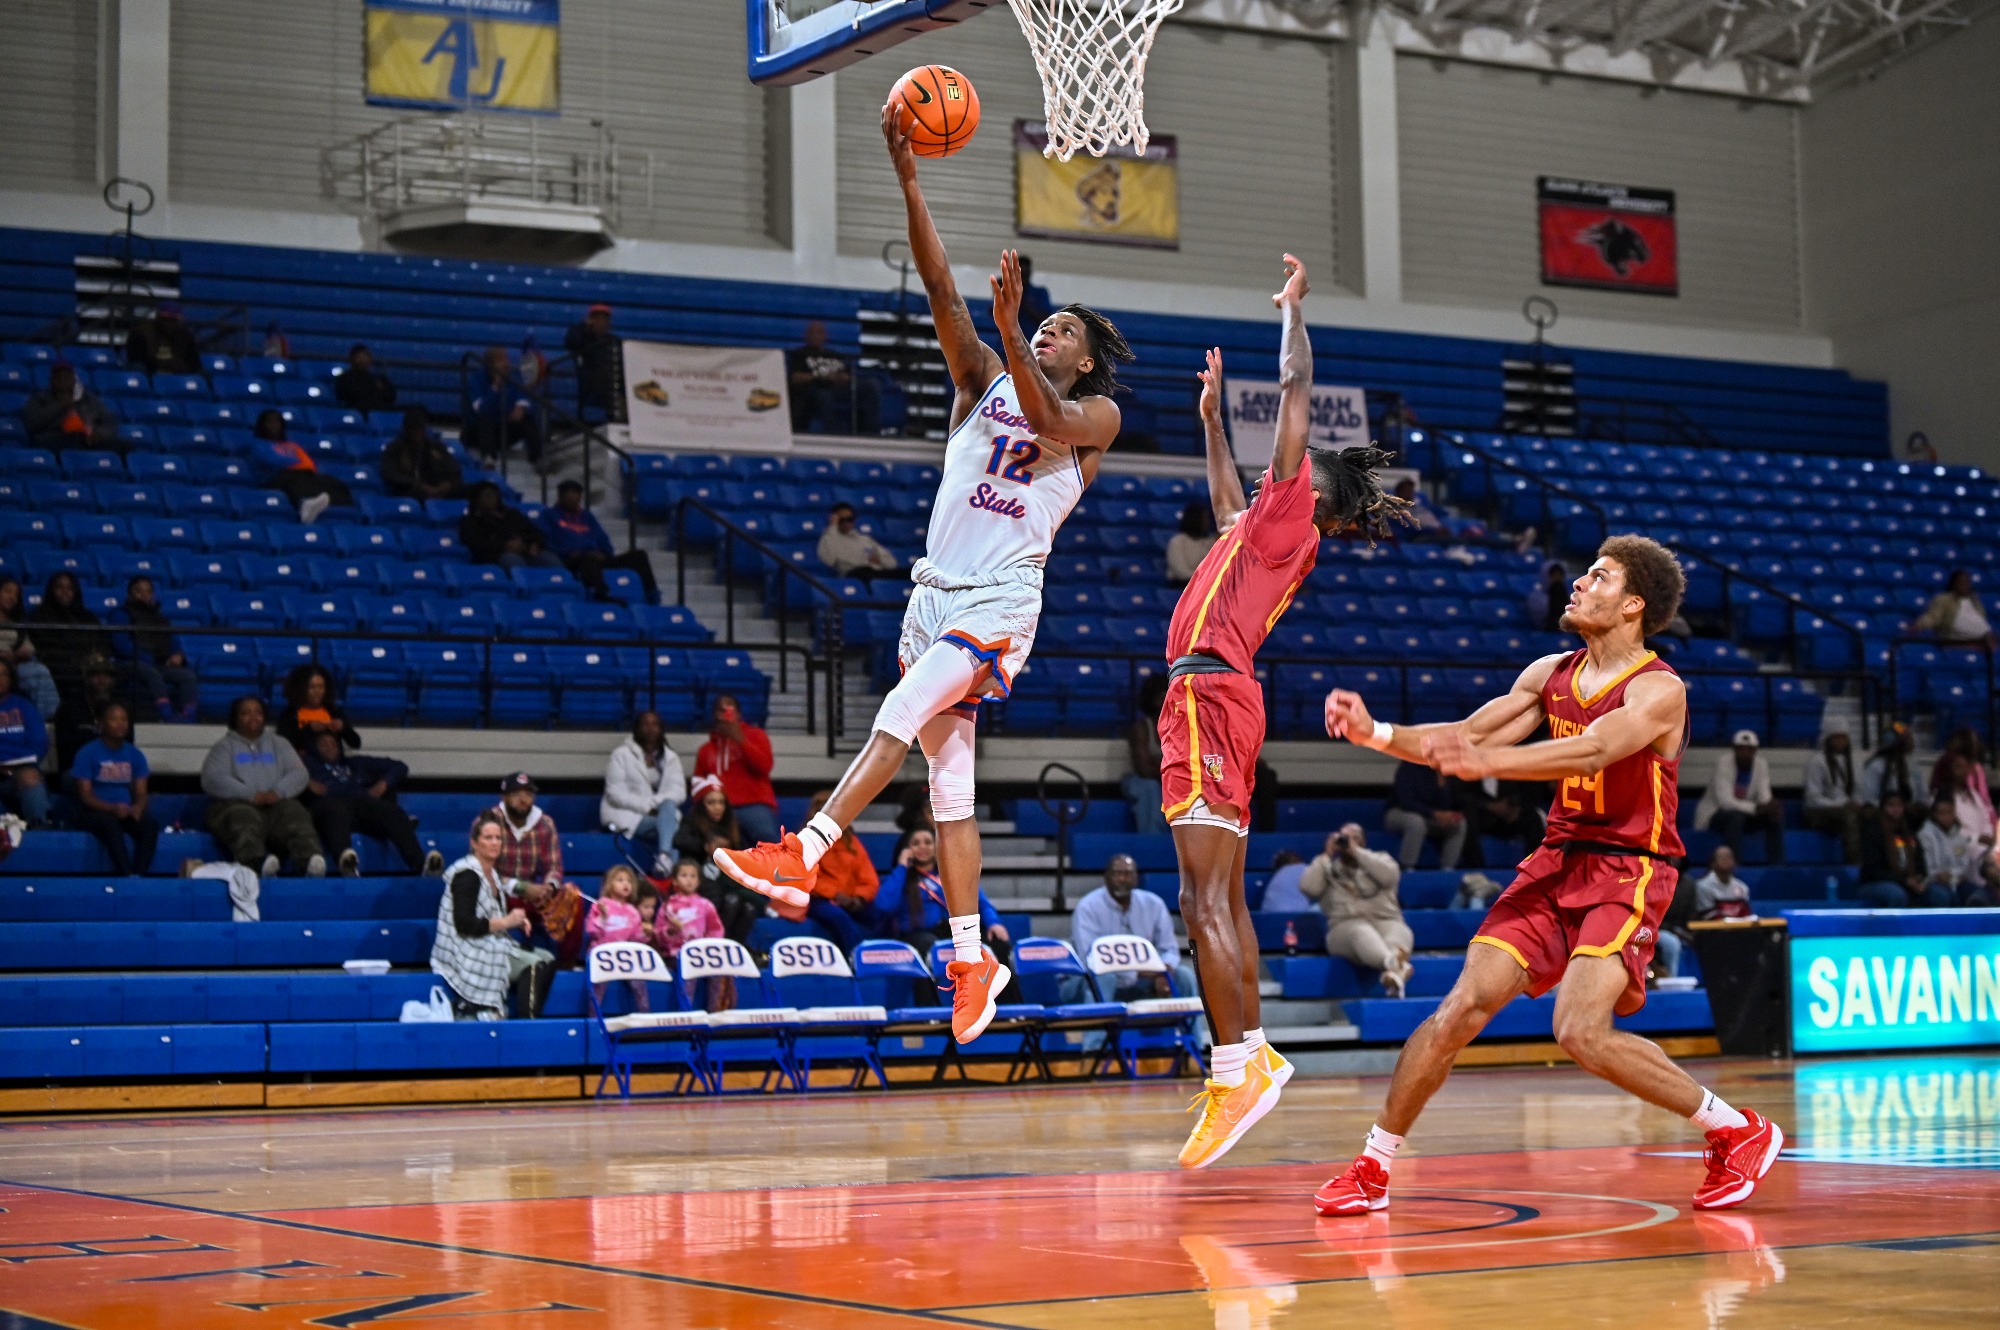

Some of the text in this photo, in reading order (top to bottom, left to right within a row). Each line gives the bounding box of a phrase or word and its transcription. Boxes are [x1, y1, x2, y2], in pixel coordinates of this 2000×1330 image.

[937, 65, 960, 101] ELIT
[1240, 390, 1351, 410] SAVNAH
[985, 433, 1042, 486] 12
[968, 482, 1025, 519] State
[1562, 769, 1605, 814] 24
[596, 950, 656, 973] SSU
[686, 945, 744, 968] SSU
[778, 944, 836, 967] SSU
[1097, 943, 1150, 965] SSU
